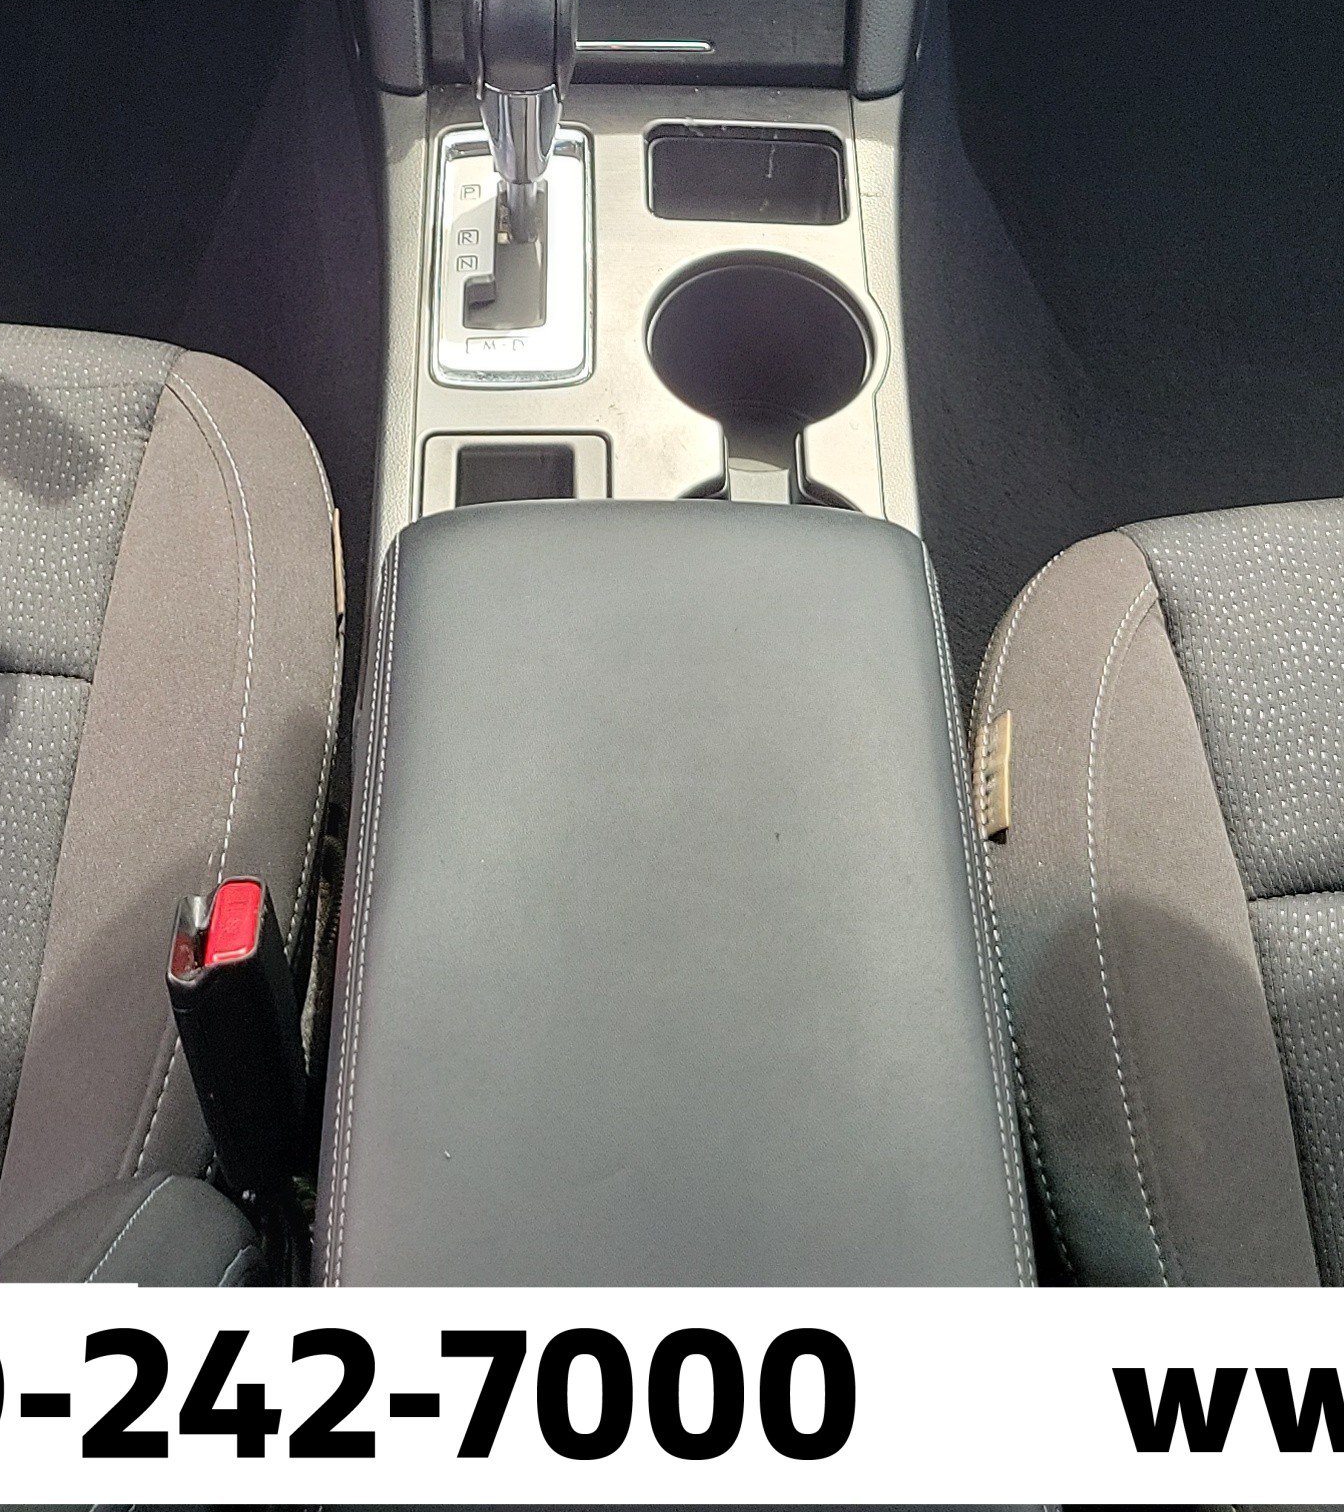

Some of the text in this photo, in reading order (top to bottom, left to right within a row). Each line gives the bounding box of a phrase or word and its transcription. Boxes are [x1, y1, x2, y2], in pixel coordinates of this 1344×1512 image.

[463, 187, 476, 199] P
[461, 232, 474, 244] R
[460, 258, 474, 270] N
